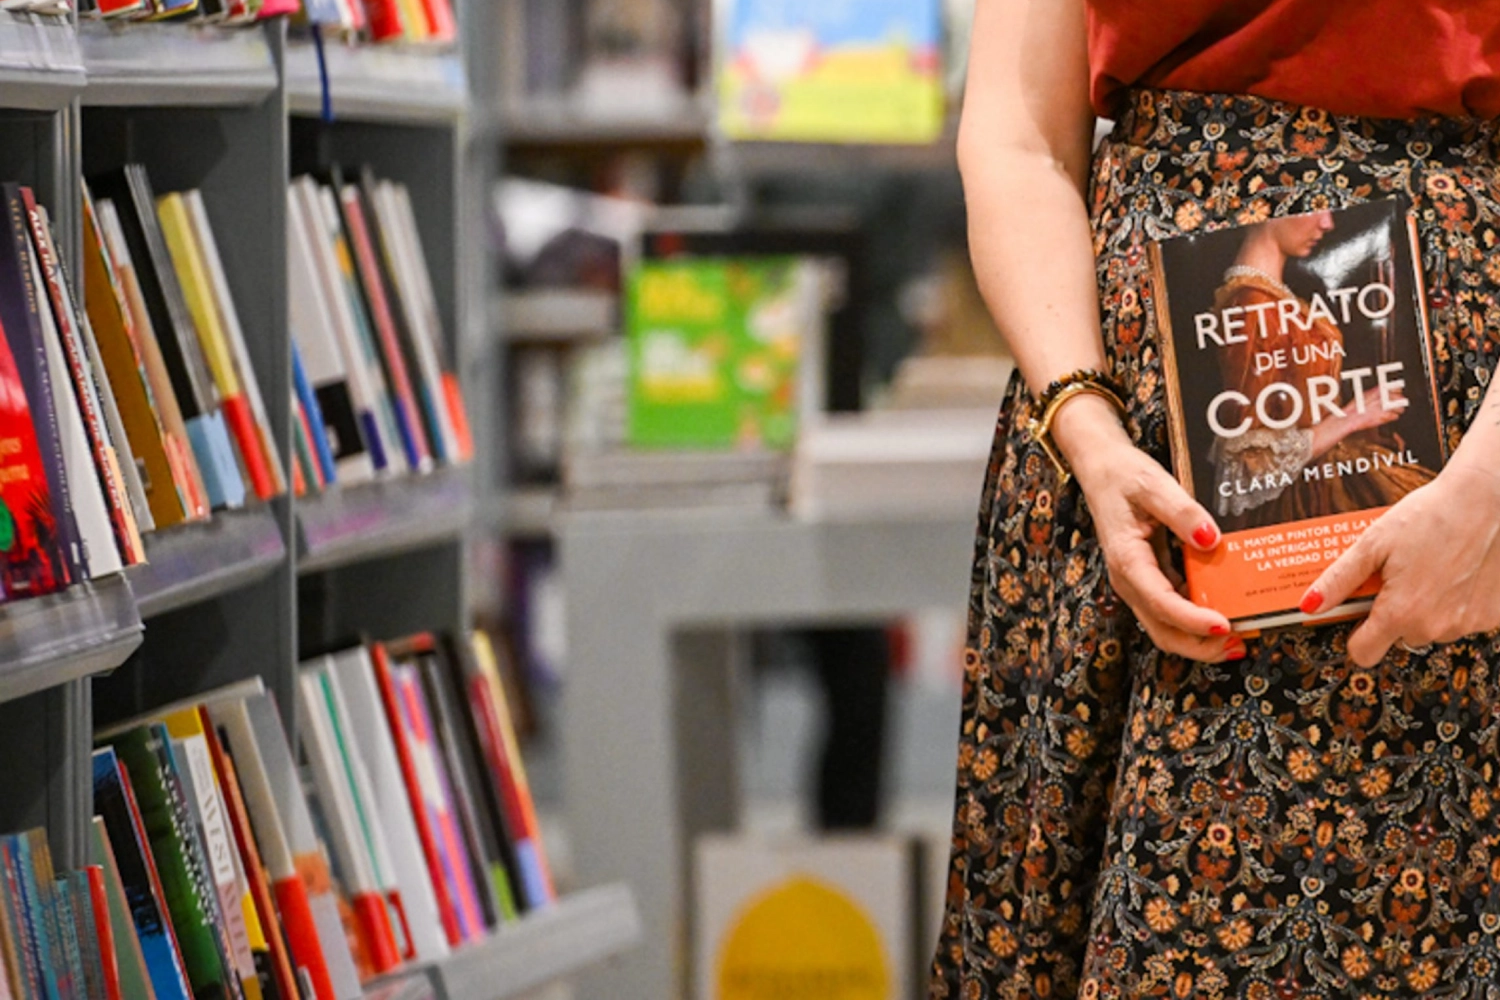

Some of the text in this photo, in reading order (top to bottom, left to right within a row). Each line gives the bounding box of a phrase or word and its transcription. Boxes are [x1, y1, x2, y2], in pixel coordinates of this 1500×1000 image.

[1195, 283, 1395, 348] RETRATO
[1254, 341, 1346, 373] DE UNA
[1207, 362, 1409, 438] CORTE
[1219, 450, 1419, 498] CLARA MENDÍVIL
[1227, 541, 1241, 551] EL
[1244, 535, 1284, 550] MAYOR
[1287, 525, 1331, 541] PINTOR
[1333, 523, 1349, 534] DE
[1352, 519, 1367, 530] LA
[1243, 550, 1265, 561] LAS
[1267, 541, 1321, 557] INTRIGAS
[1324, 536, 1340, 547] DE
[1257, 560, 1272, 572] LA
[1274, 552, 1321, 569] VERDAD
[1324, 548, 1340, 560] DE
